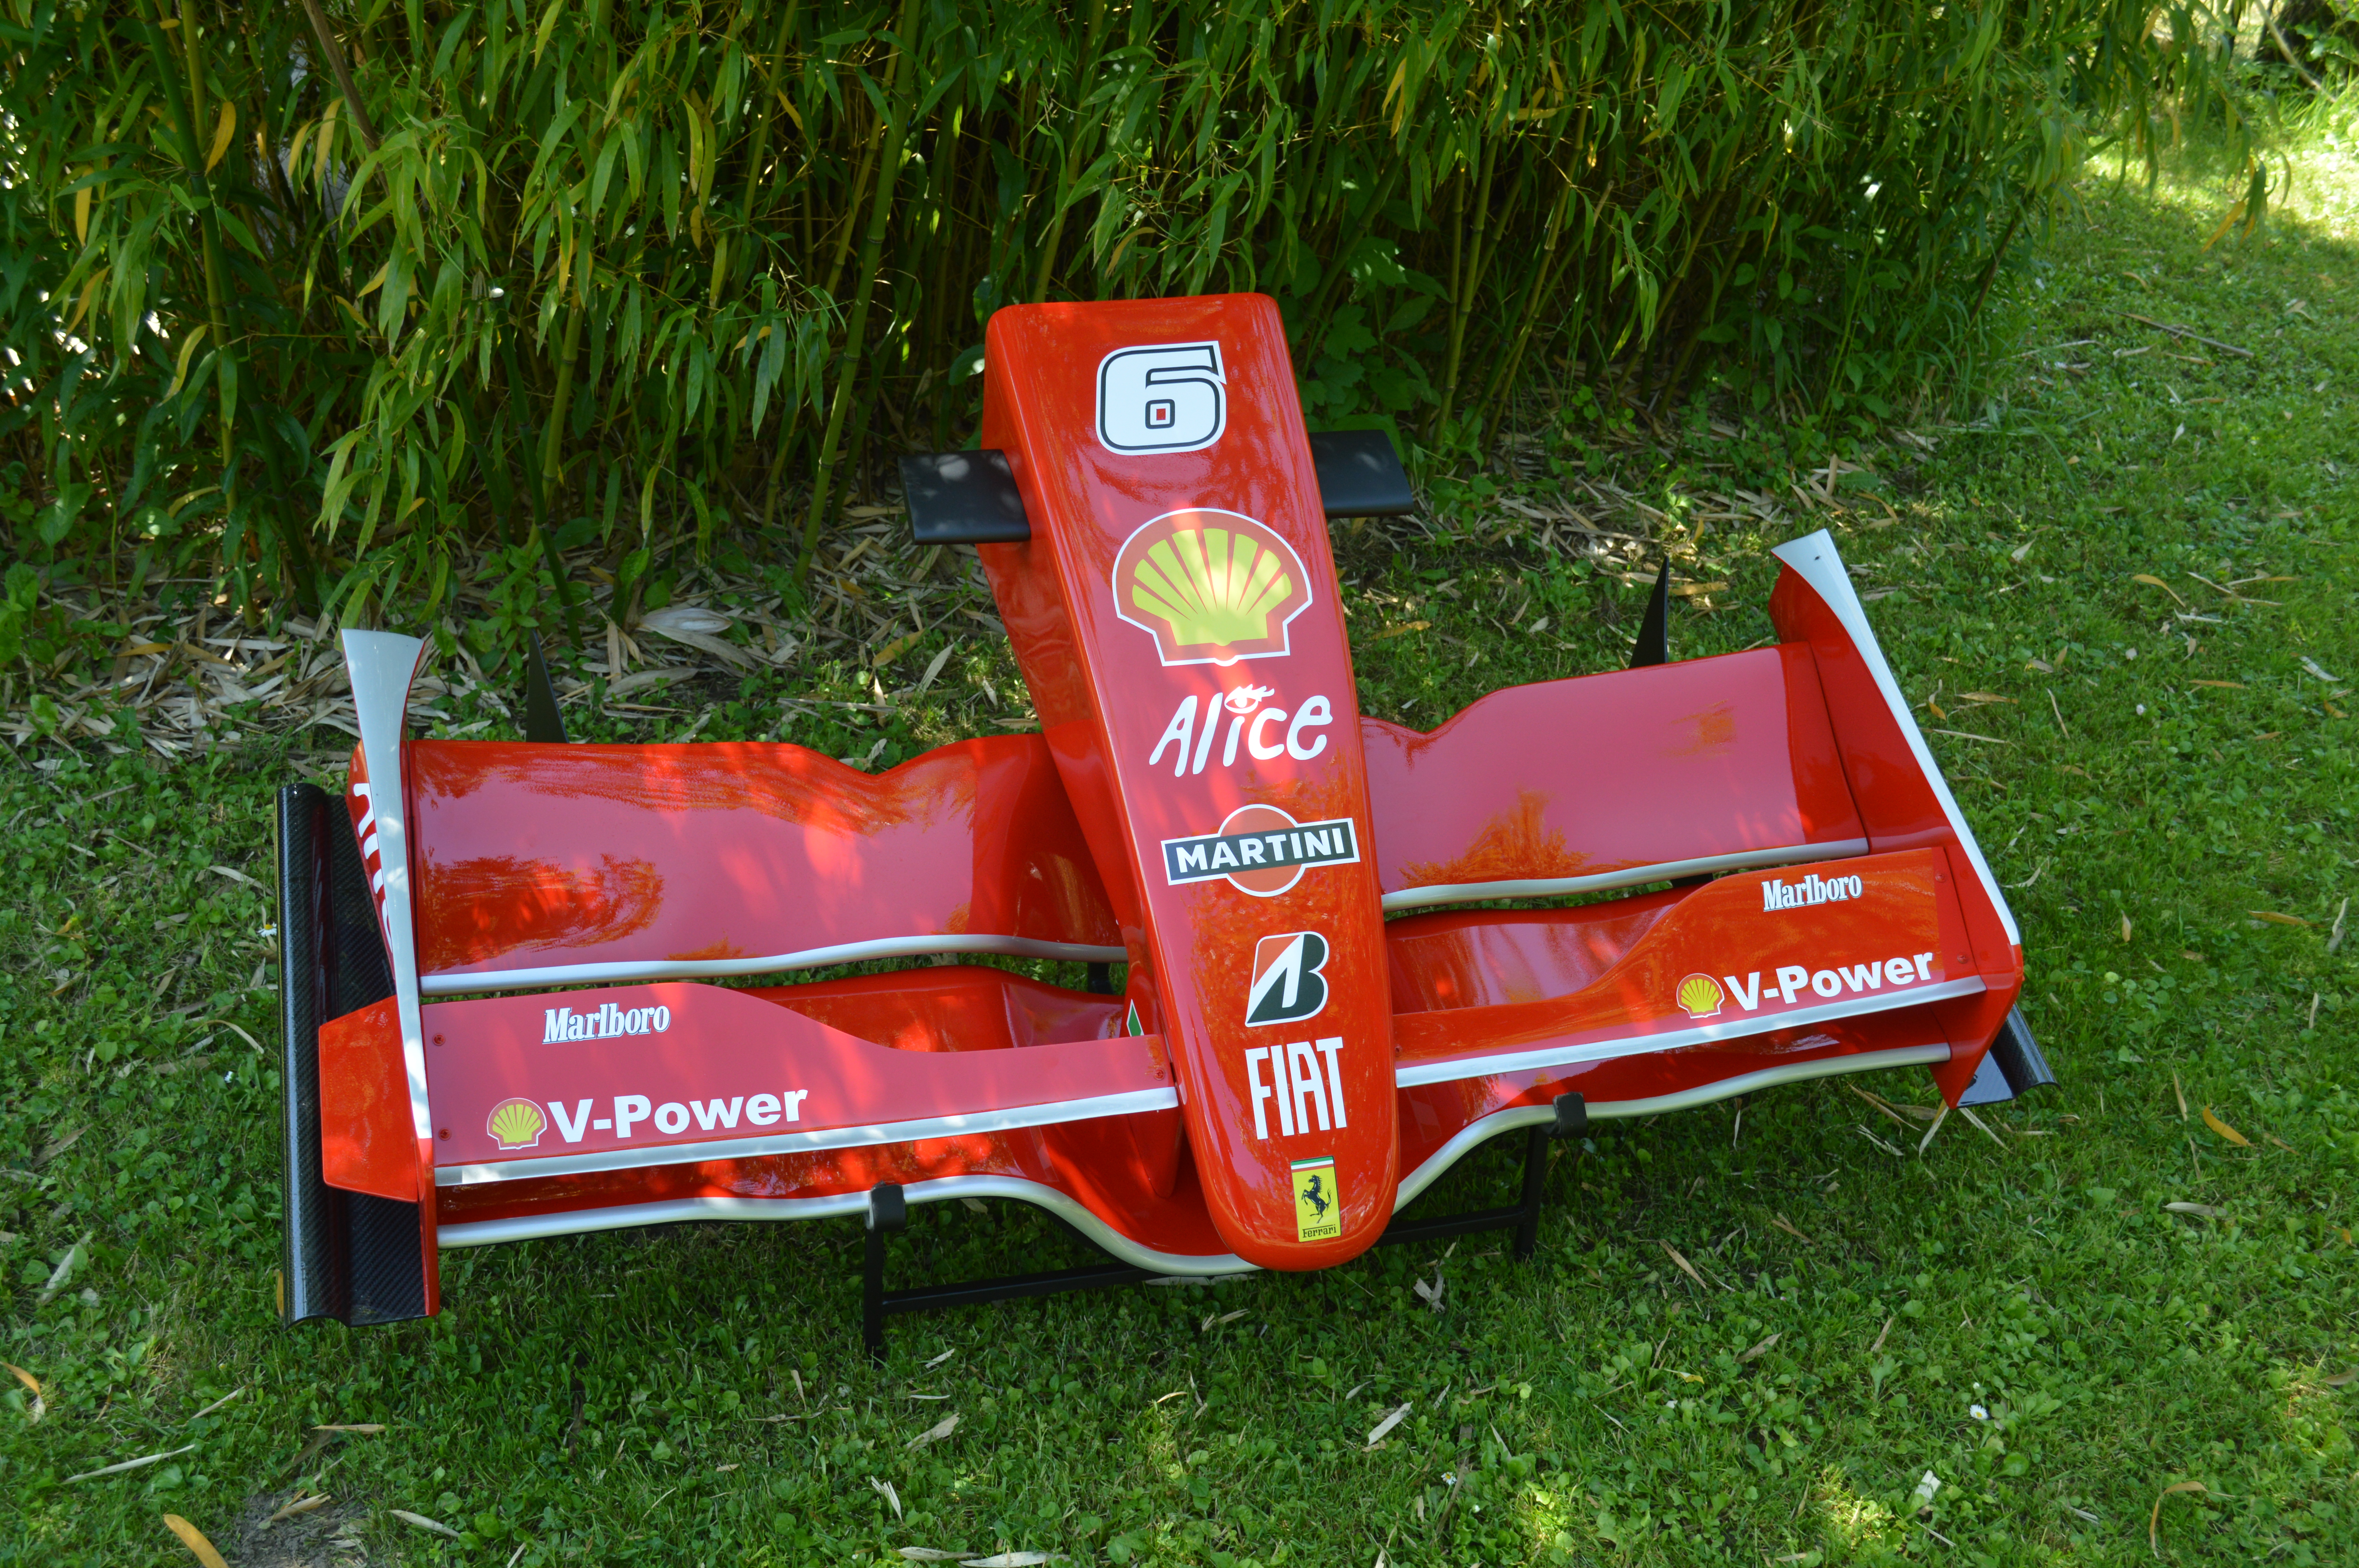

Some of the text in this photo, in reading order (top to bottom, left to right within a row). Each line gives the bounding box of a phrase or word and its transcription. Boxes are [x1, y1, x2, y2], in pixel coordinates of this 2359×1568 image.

[1096, 340, 1226, 456] 6
[1149, 685, 1332, 777] Alice
[1176, 828, 1345, 873] MARTINI
[1761, 874, 1862, 912] Marlboro
[1723, 952, 1933, 1011] V-Power
[542, 1002, 671, 1044] Marlboro
[1245, 1036, 1347, 1140] FIAT
[547, 1089, 808, 1143] V-Power
[1302, 1224, 1336, 1238] Ferrari
